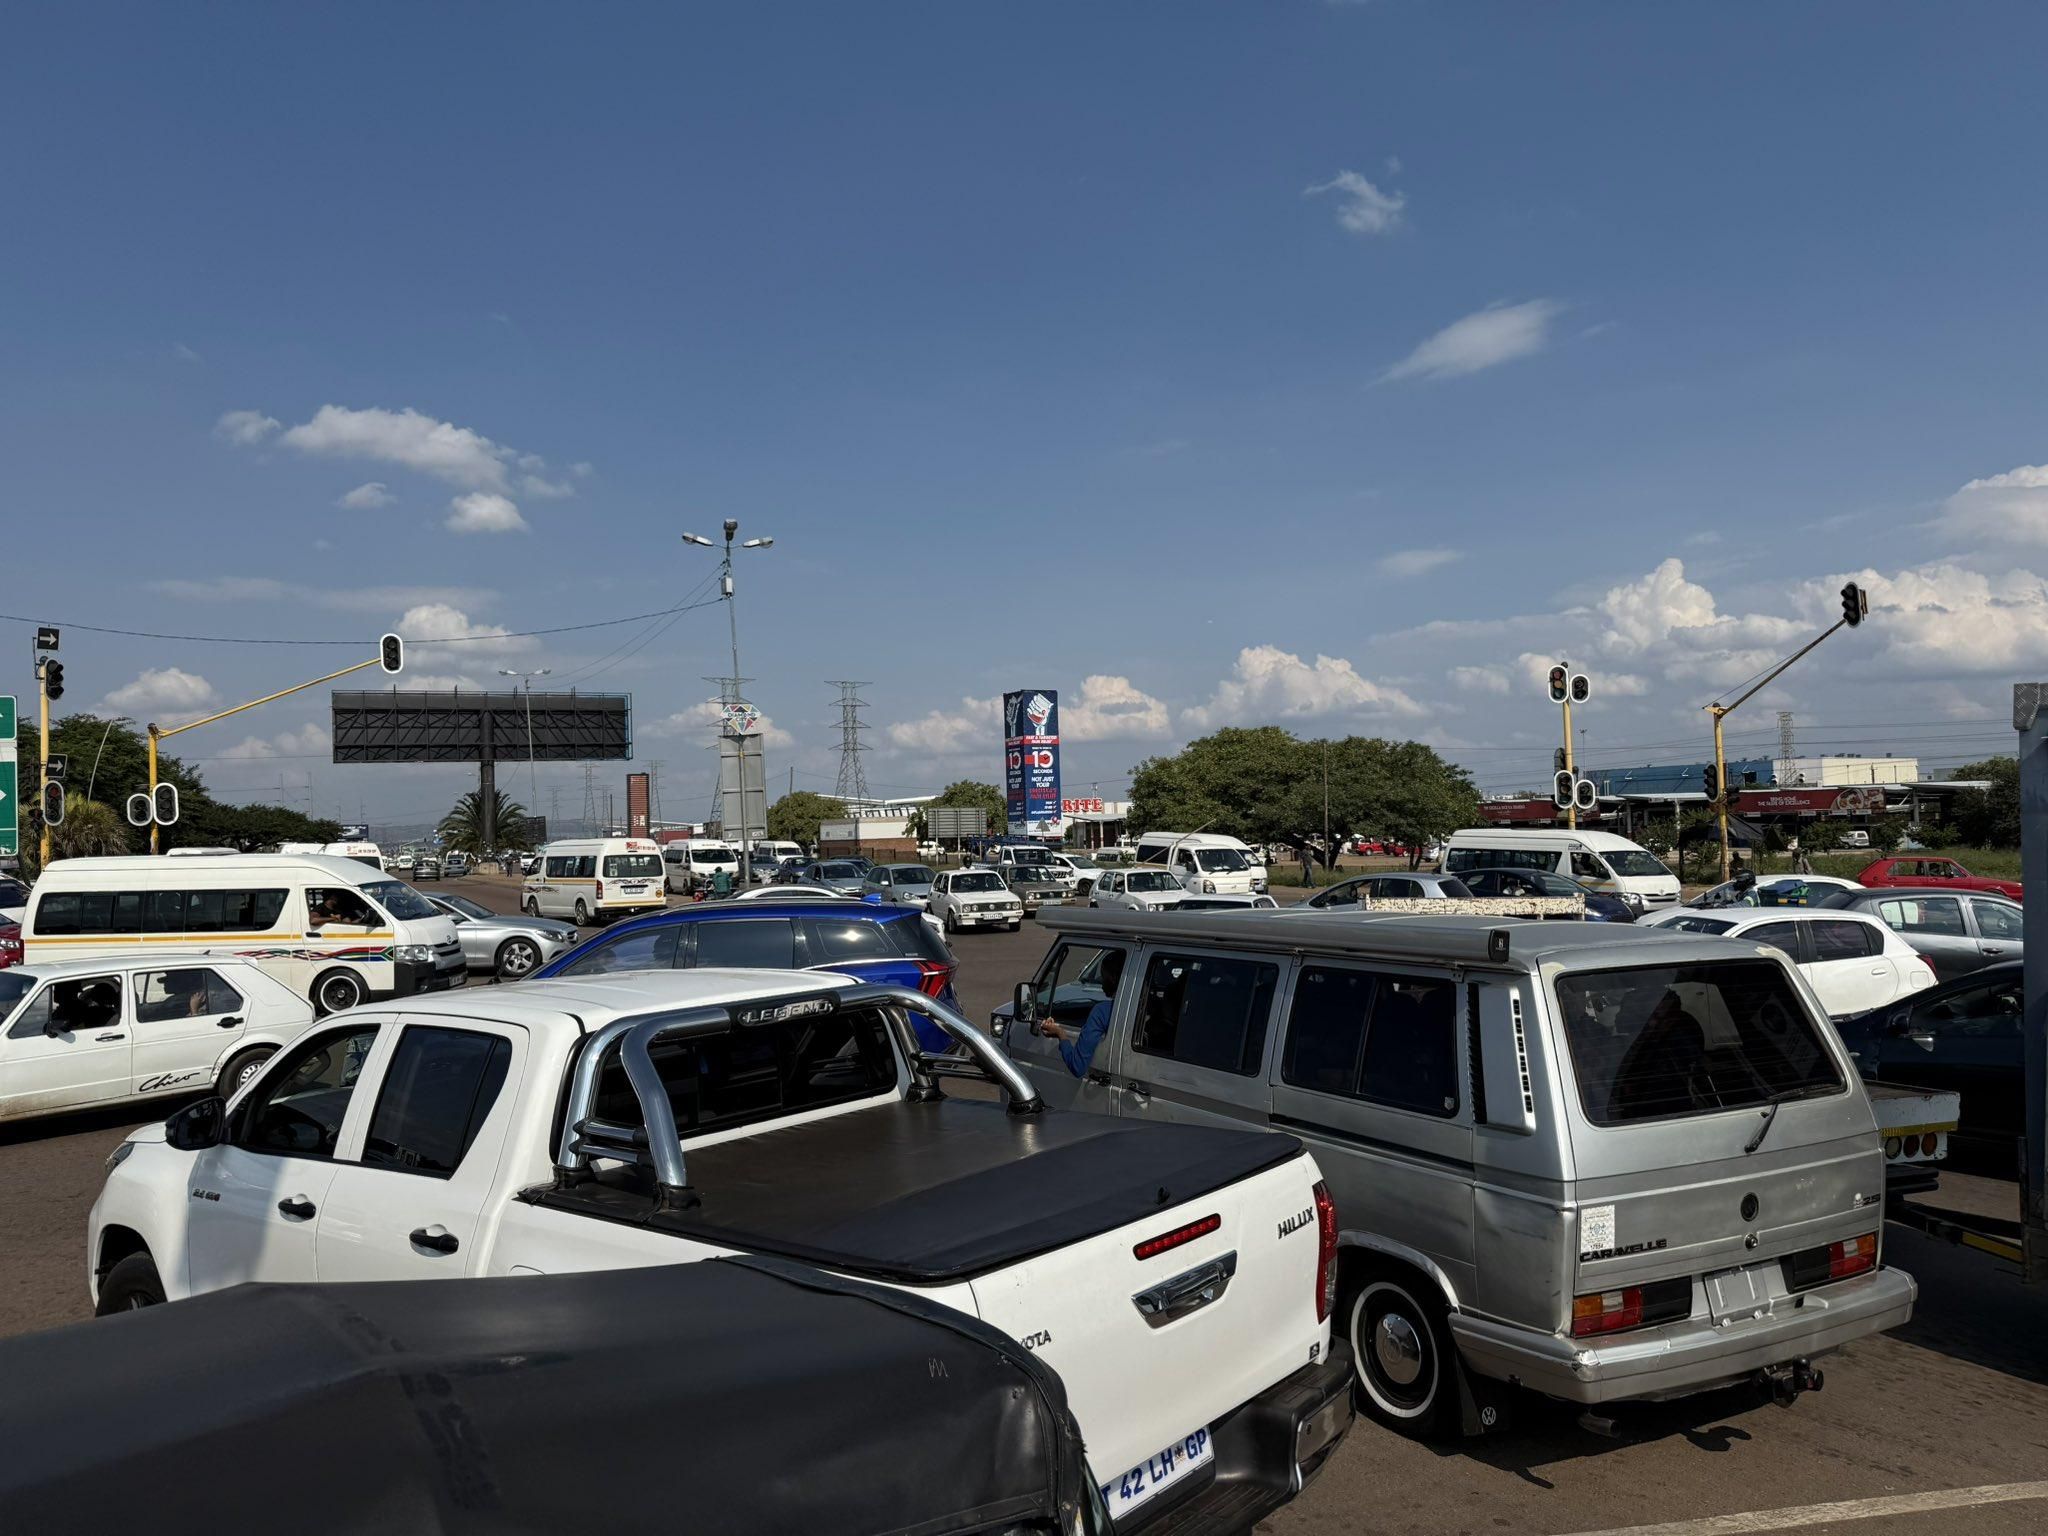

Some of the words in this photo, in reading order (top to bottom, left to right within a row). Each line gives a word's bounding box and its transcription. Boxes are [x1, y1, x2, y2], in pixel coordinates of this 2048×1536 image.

[1032, 750, 1053, 768] 10
[1061, 798, 1103, 812] RITE
[744, 999, 830, 1023] LEGEND
[138, 1072, 201, 1092] Chico
[1277, 1206, 1315, 1240] HILUX
[1580, 1238, 1668, 1262] CARAVELLE
[1120, 1467, 1145, 1500] 42
[1149, 1447, 1176, 1484] LH
[1184, 1427, 1207, 1461] GP
